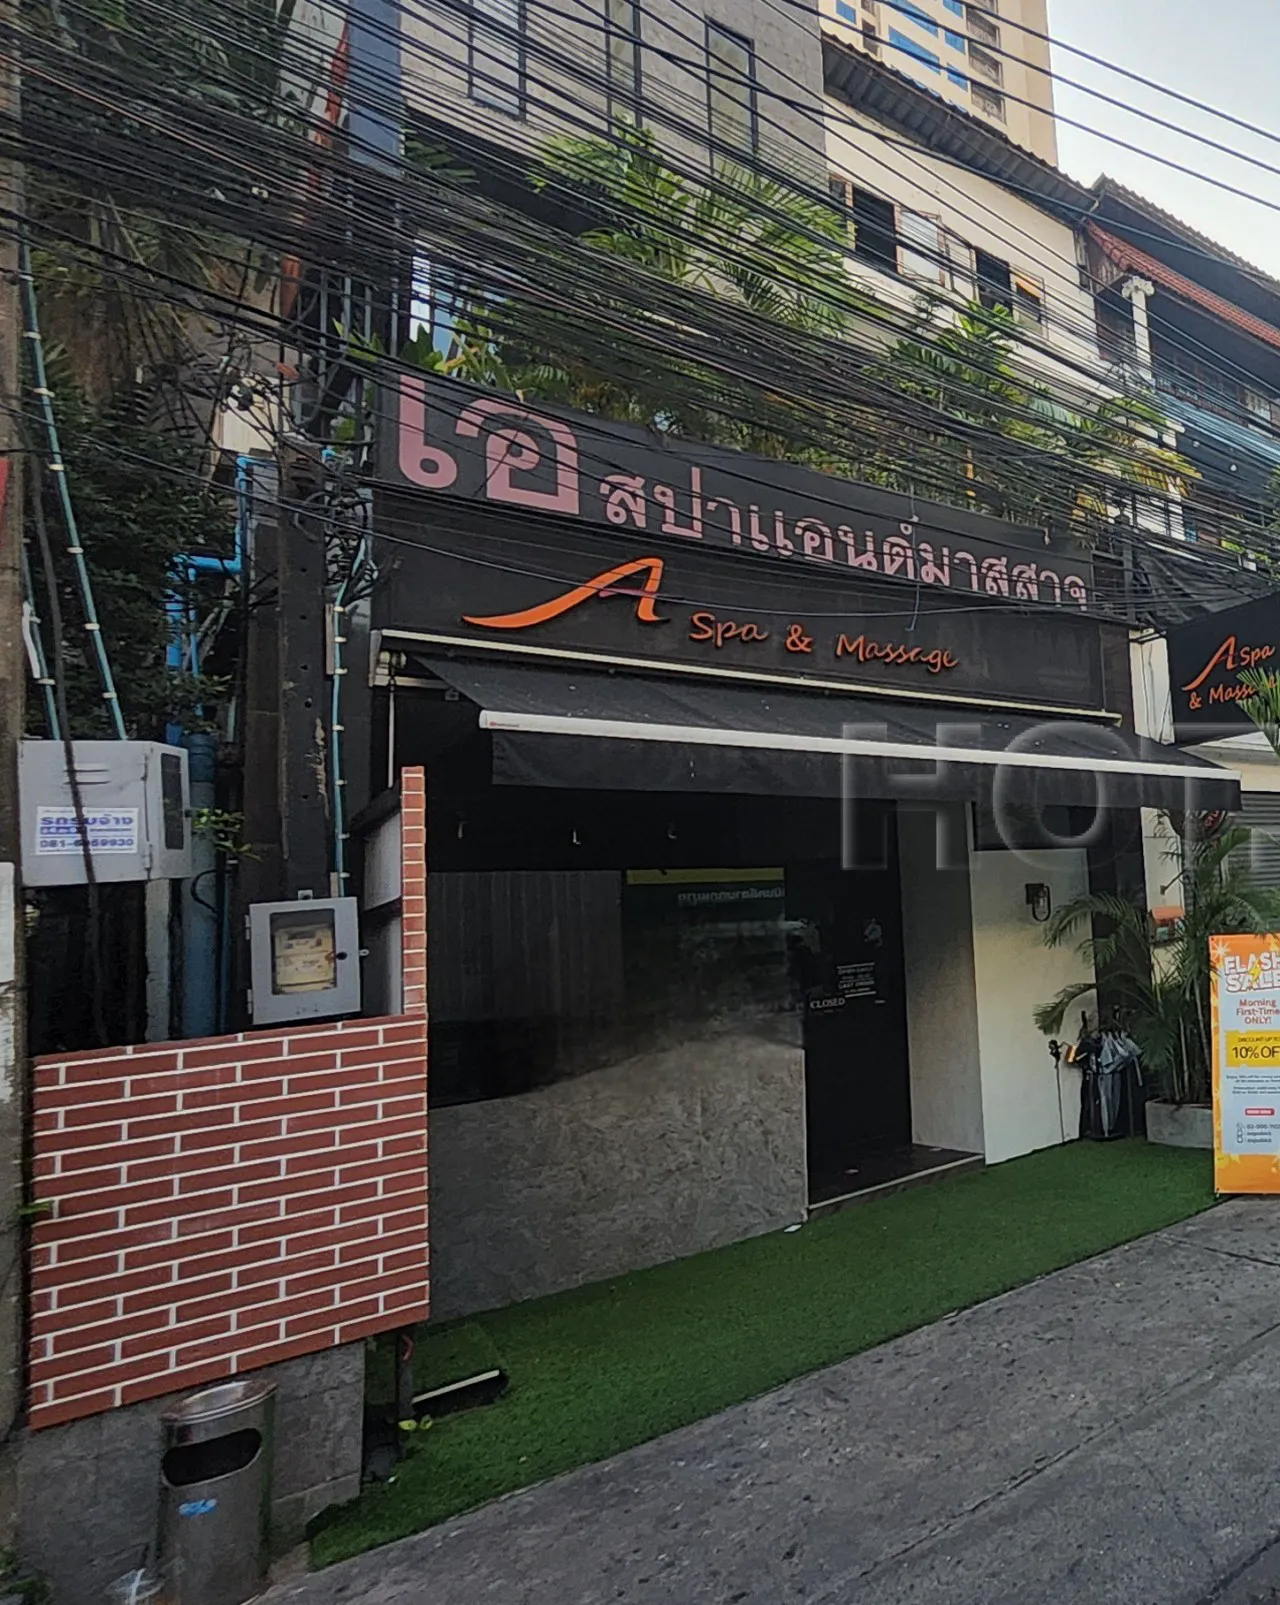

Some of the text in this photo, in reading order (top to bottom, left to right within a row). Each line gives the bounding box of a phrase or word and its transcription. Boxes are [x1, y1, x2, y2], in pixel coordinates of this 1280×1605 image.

[399, 374, 580, 515] เอ
[462, 557, 959, 674] A Spa & Massage
[1181, 635, 1276, 691] A Spa
[1189, 691, 1203, 710] &
[1239, 998, 1277, 1008] Morning
[1235, 1007, 1280, 1017] First-Time
[1244, 1016, 1272, 1025] ONLY!
[1231, 1045, 1260, 1060] 10%
